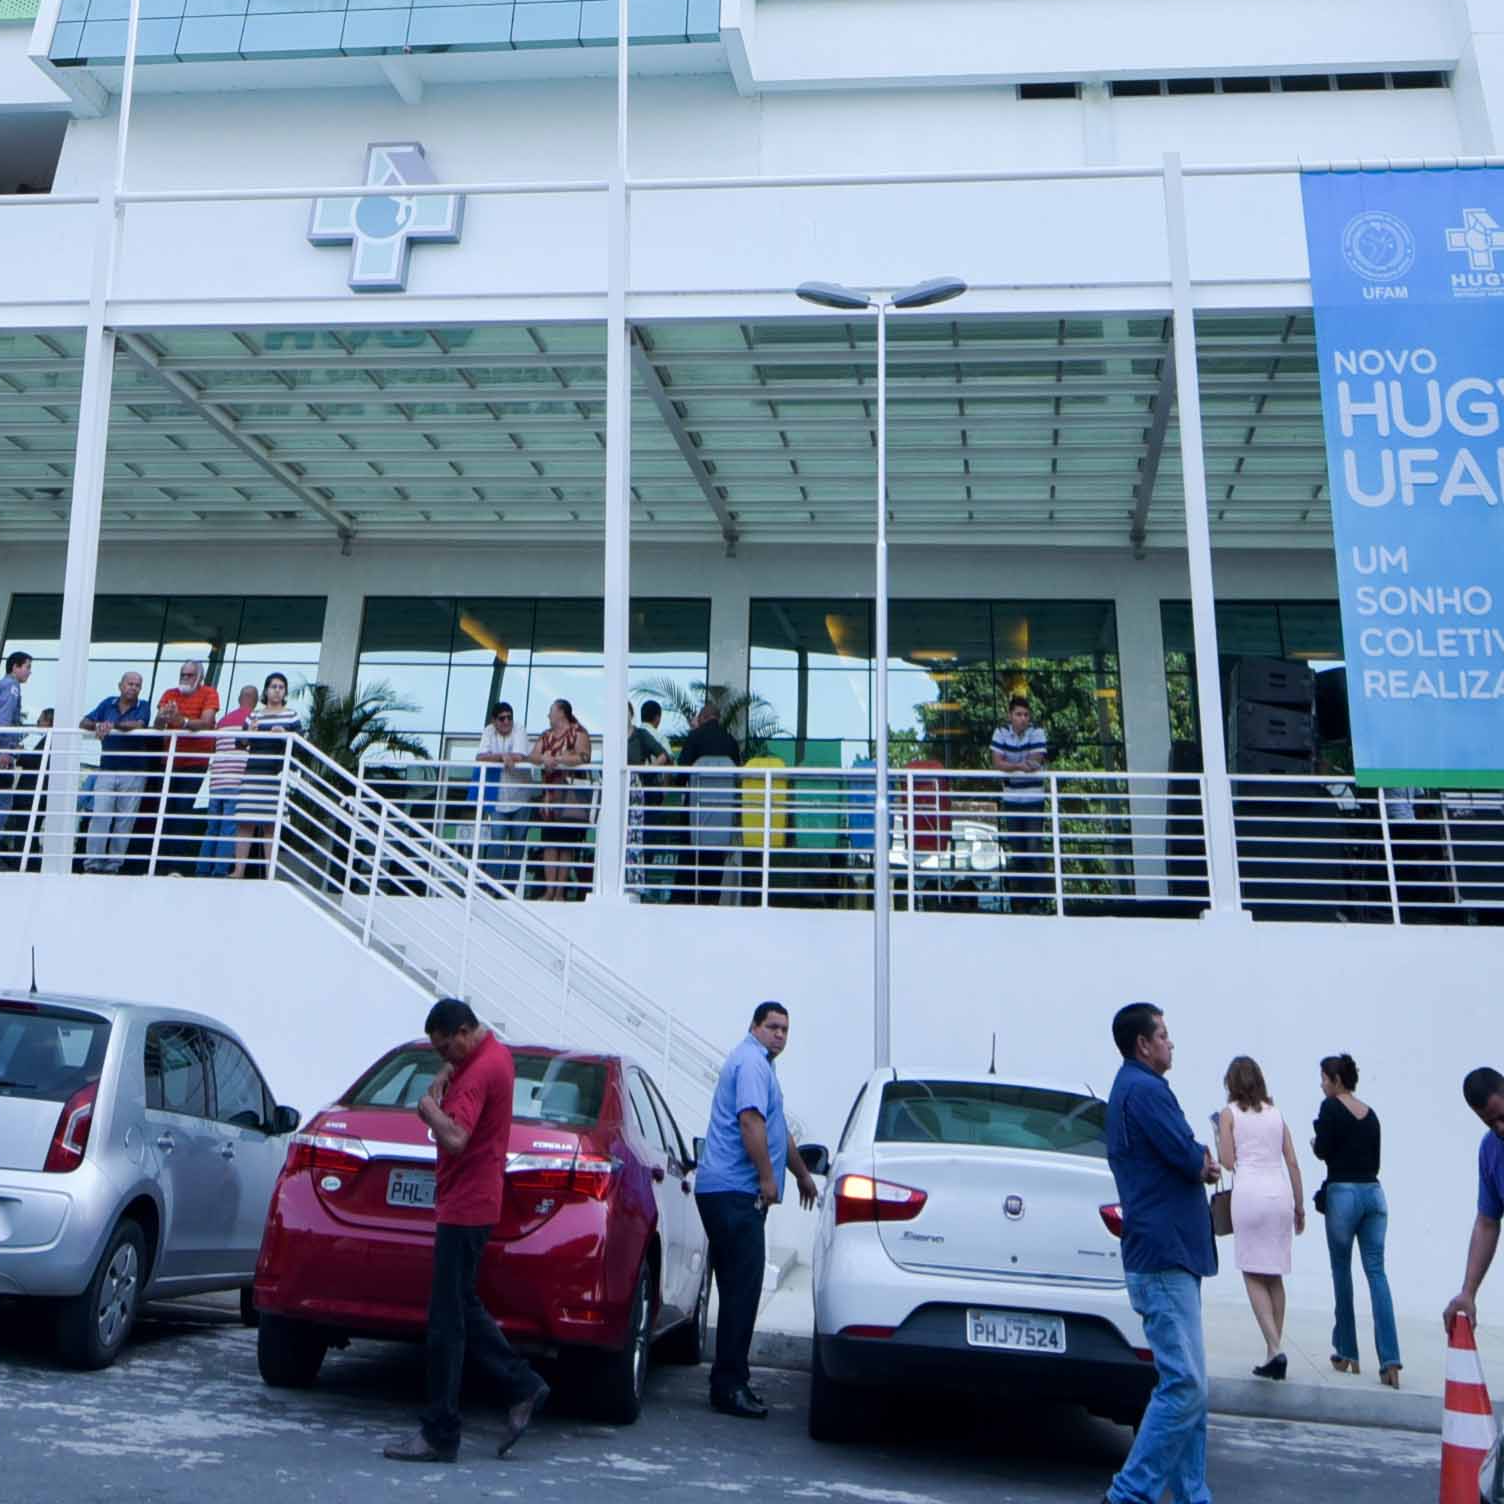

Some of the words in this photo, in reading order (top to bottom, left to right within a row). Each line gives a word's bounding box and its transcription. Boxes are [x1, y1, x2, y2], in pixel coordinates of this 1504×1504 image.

[1363, 287, 1408, 299] UFAM
[1334, 348, 1438, 376] NOVO
[1352, 545, 1409, 576] UM
[1356, 585, 1493, 616] SONHO
[974, 1322, 1059, 1348] PHJ-7524
